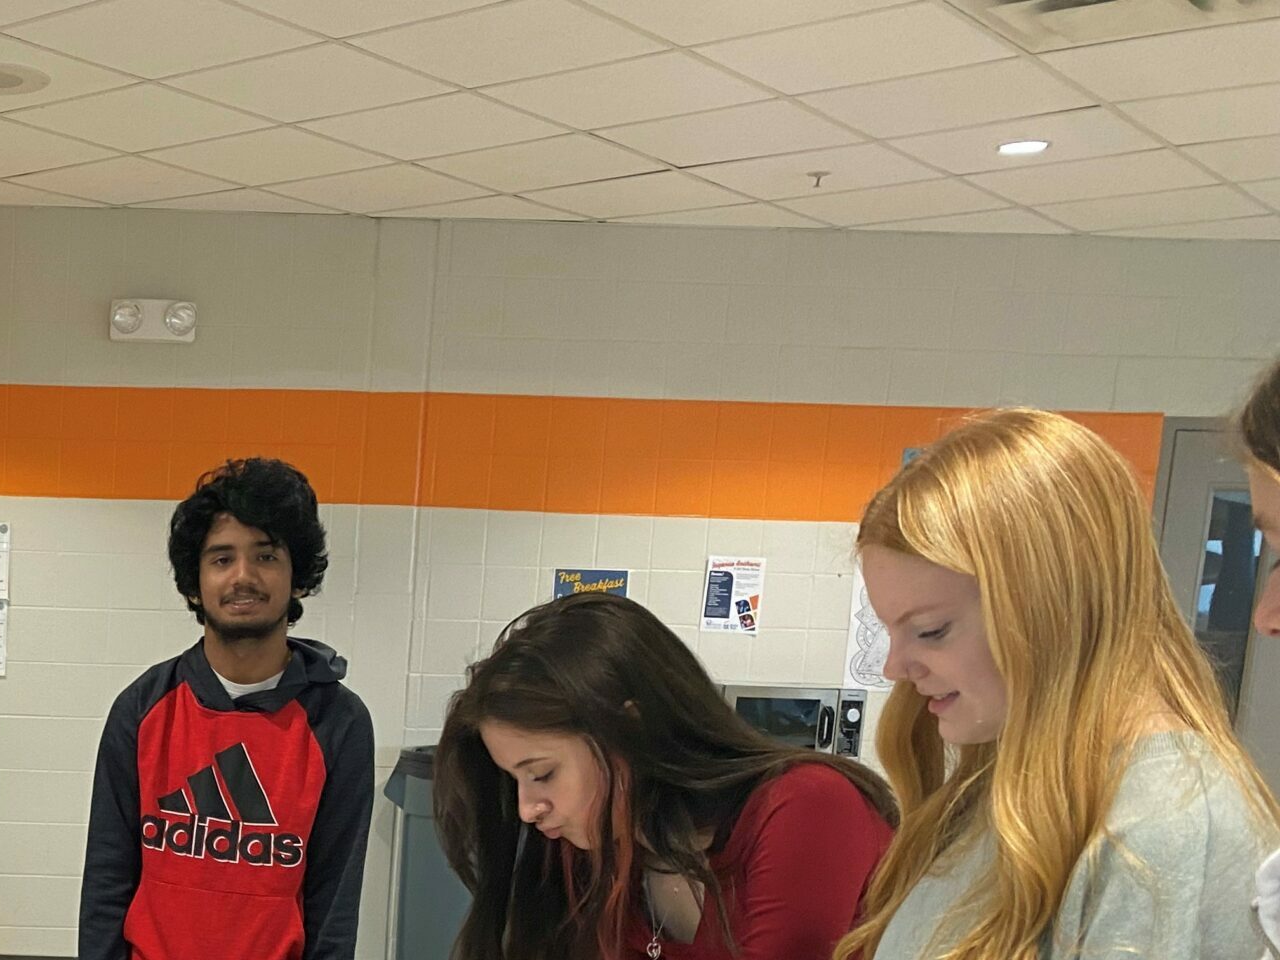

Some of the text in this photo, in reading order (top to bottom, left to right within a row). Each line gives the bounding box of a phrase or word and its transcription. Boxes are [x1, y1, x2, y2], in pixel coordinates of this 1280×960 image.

[558, 572, 581, 584] Free
[574, 578, 624, 592] Breakfast
[142, 814, 303, 868] adidas
